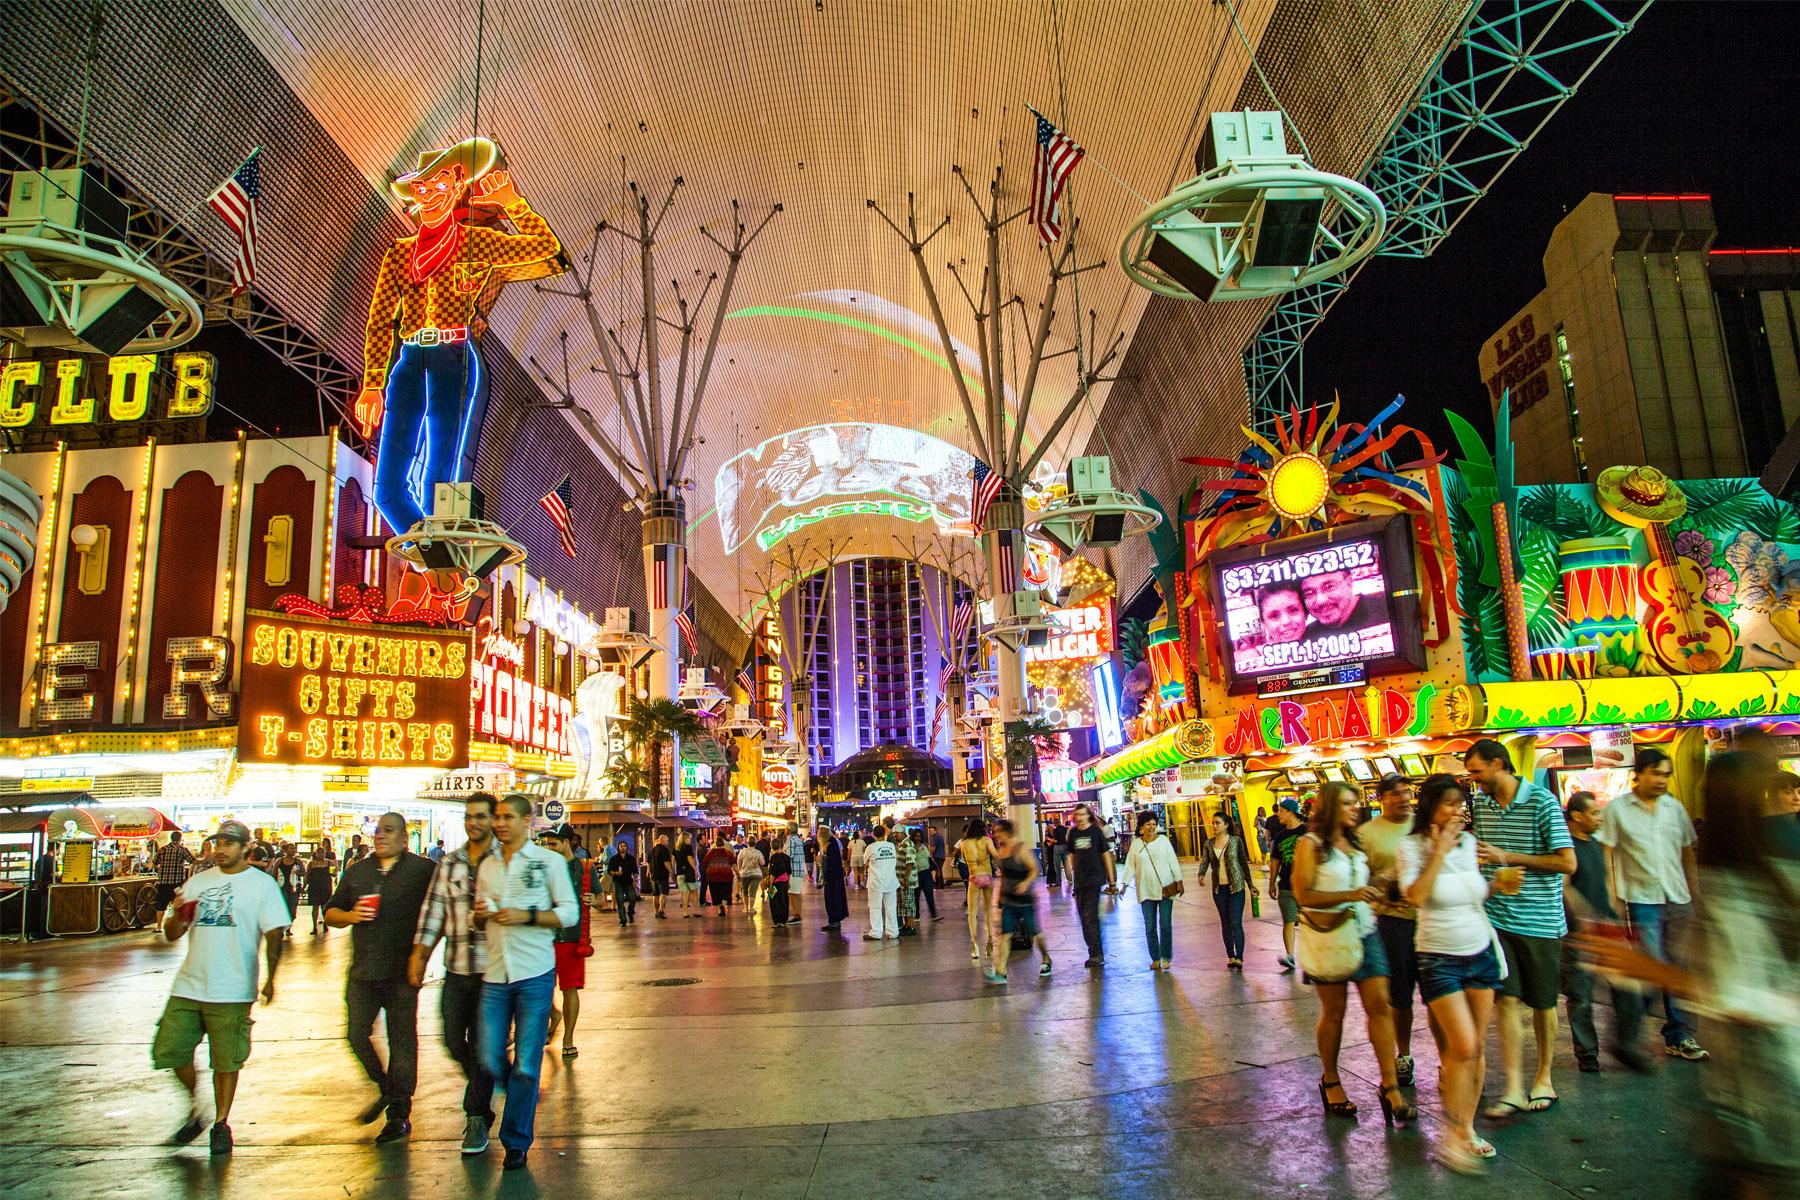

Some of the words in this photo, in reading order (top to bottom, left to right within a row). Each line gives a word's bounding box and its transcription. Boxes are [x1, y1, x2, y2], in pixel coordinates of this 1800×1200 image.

[1494, 313, 1535, 367] LAS
[0, 352, 215, 427] CLUB
[1488, 333, 1553, 401] VEGAS
[1508, 370, 1550, 421] LUB
[1225, 543, 1375, 592] $3,211,623.52
[252, 624, 467, 679] SOUVENIRS
[1319, 631, 1362, 660] 2003
[299, 675, 416, 718] GIFTS
[768, 665, 784, 736] GATE
[1292, 676, 1326, 686] GENUINE
[471, 659, 574, 754] PIONEER
[260, 715, 454, 761] T-SHIRTS
[608, 720, 624, 769] ABC
[427, 776, 486, 791] HIRTS
[764, 771, 793, 783] HOTEL
[875, 789, 918, 798] OSCAR'S
